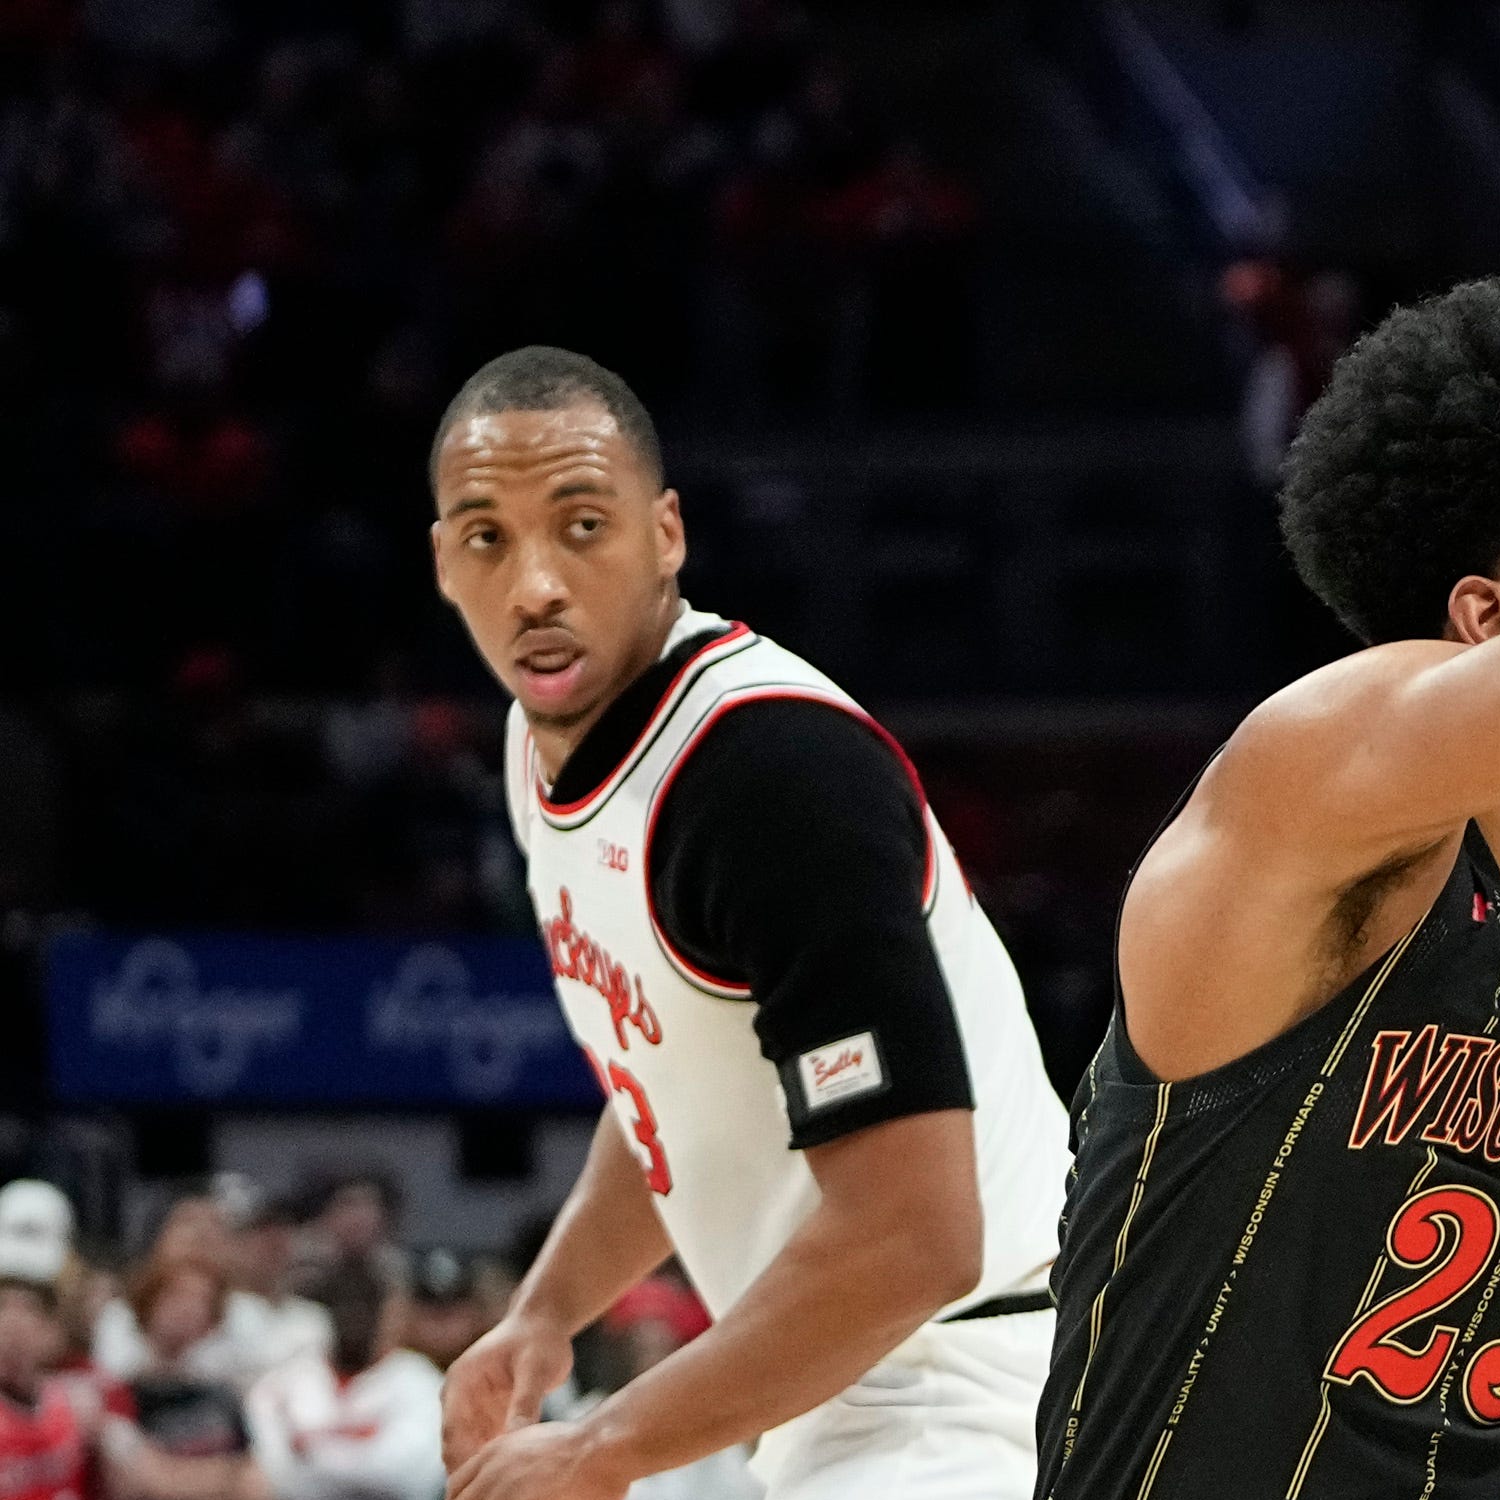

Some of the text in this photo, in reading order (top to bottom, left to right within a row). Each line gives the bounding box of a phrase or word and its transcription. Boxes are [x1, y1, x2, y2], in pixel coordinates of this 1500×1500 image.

[1168, 1081, 1325, 1425] EQUALITY UNITY WISCONSIN FORWARD
